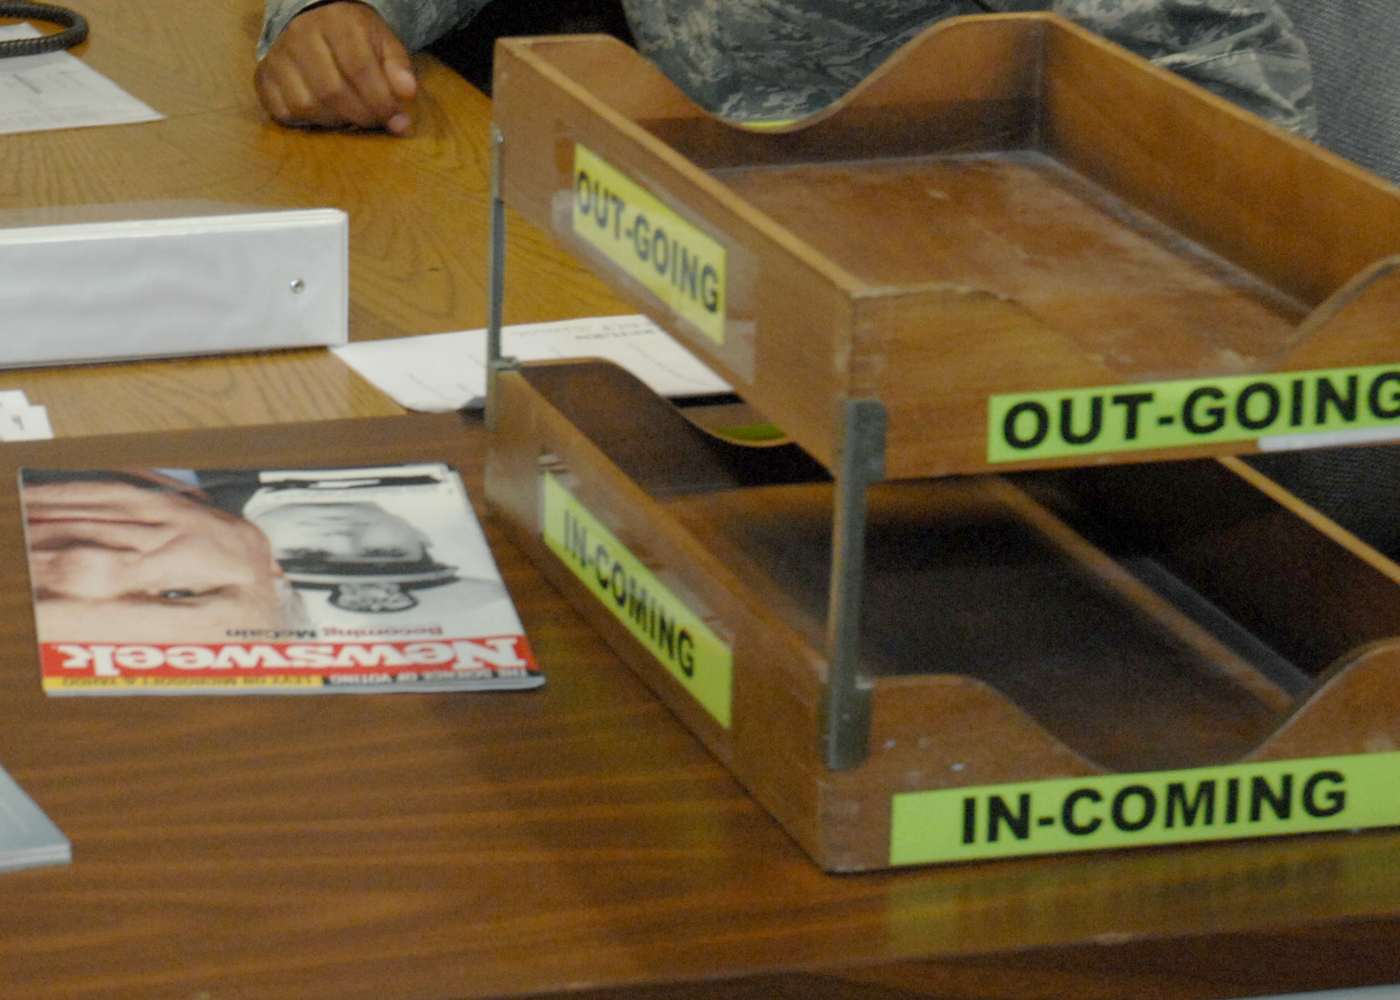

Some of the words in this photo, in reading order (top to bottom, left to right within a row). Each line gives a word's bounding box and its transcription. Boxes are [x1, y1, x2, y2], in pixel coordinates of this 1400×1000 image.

[576, 170, 718, 313] OUT-GOING
[1003, 370, 1400, 450] OUT-GOING
[564, 509, 695, 678] IN-COMING
[58, 636, 527, 676] Newsweek
[225, 628, 319, 639] McCain
[323, 627, 443, 638] Becoming
[961, 771, 1347, 844] IN-COMING
